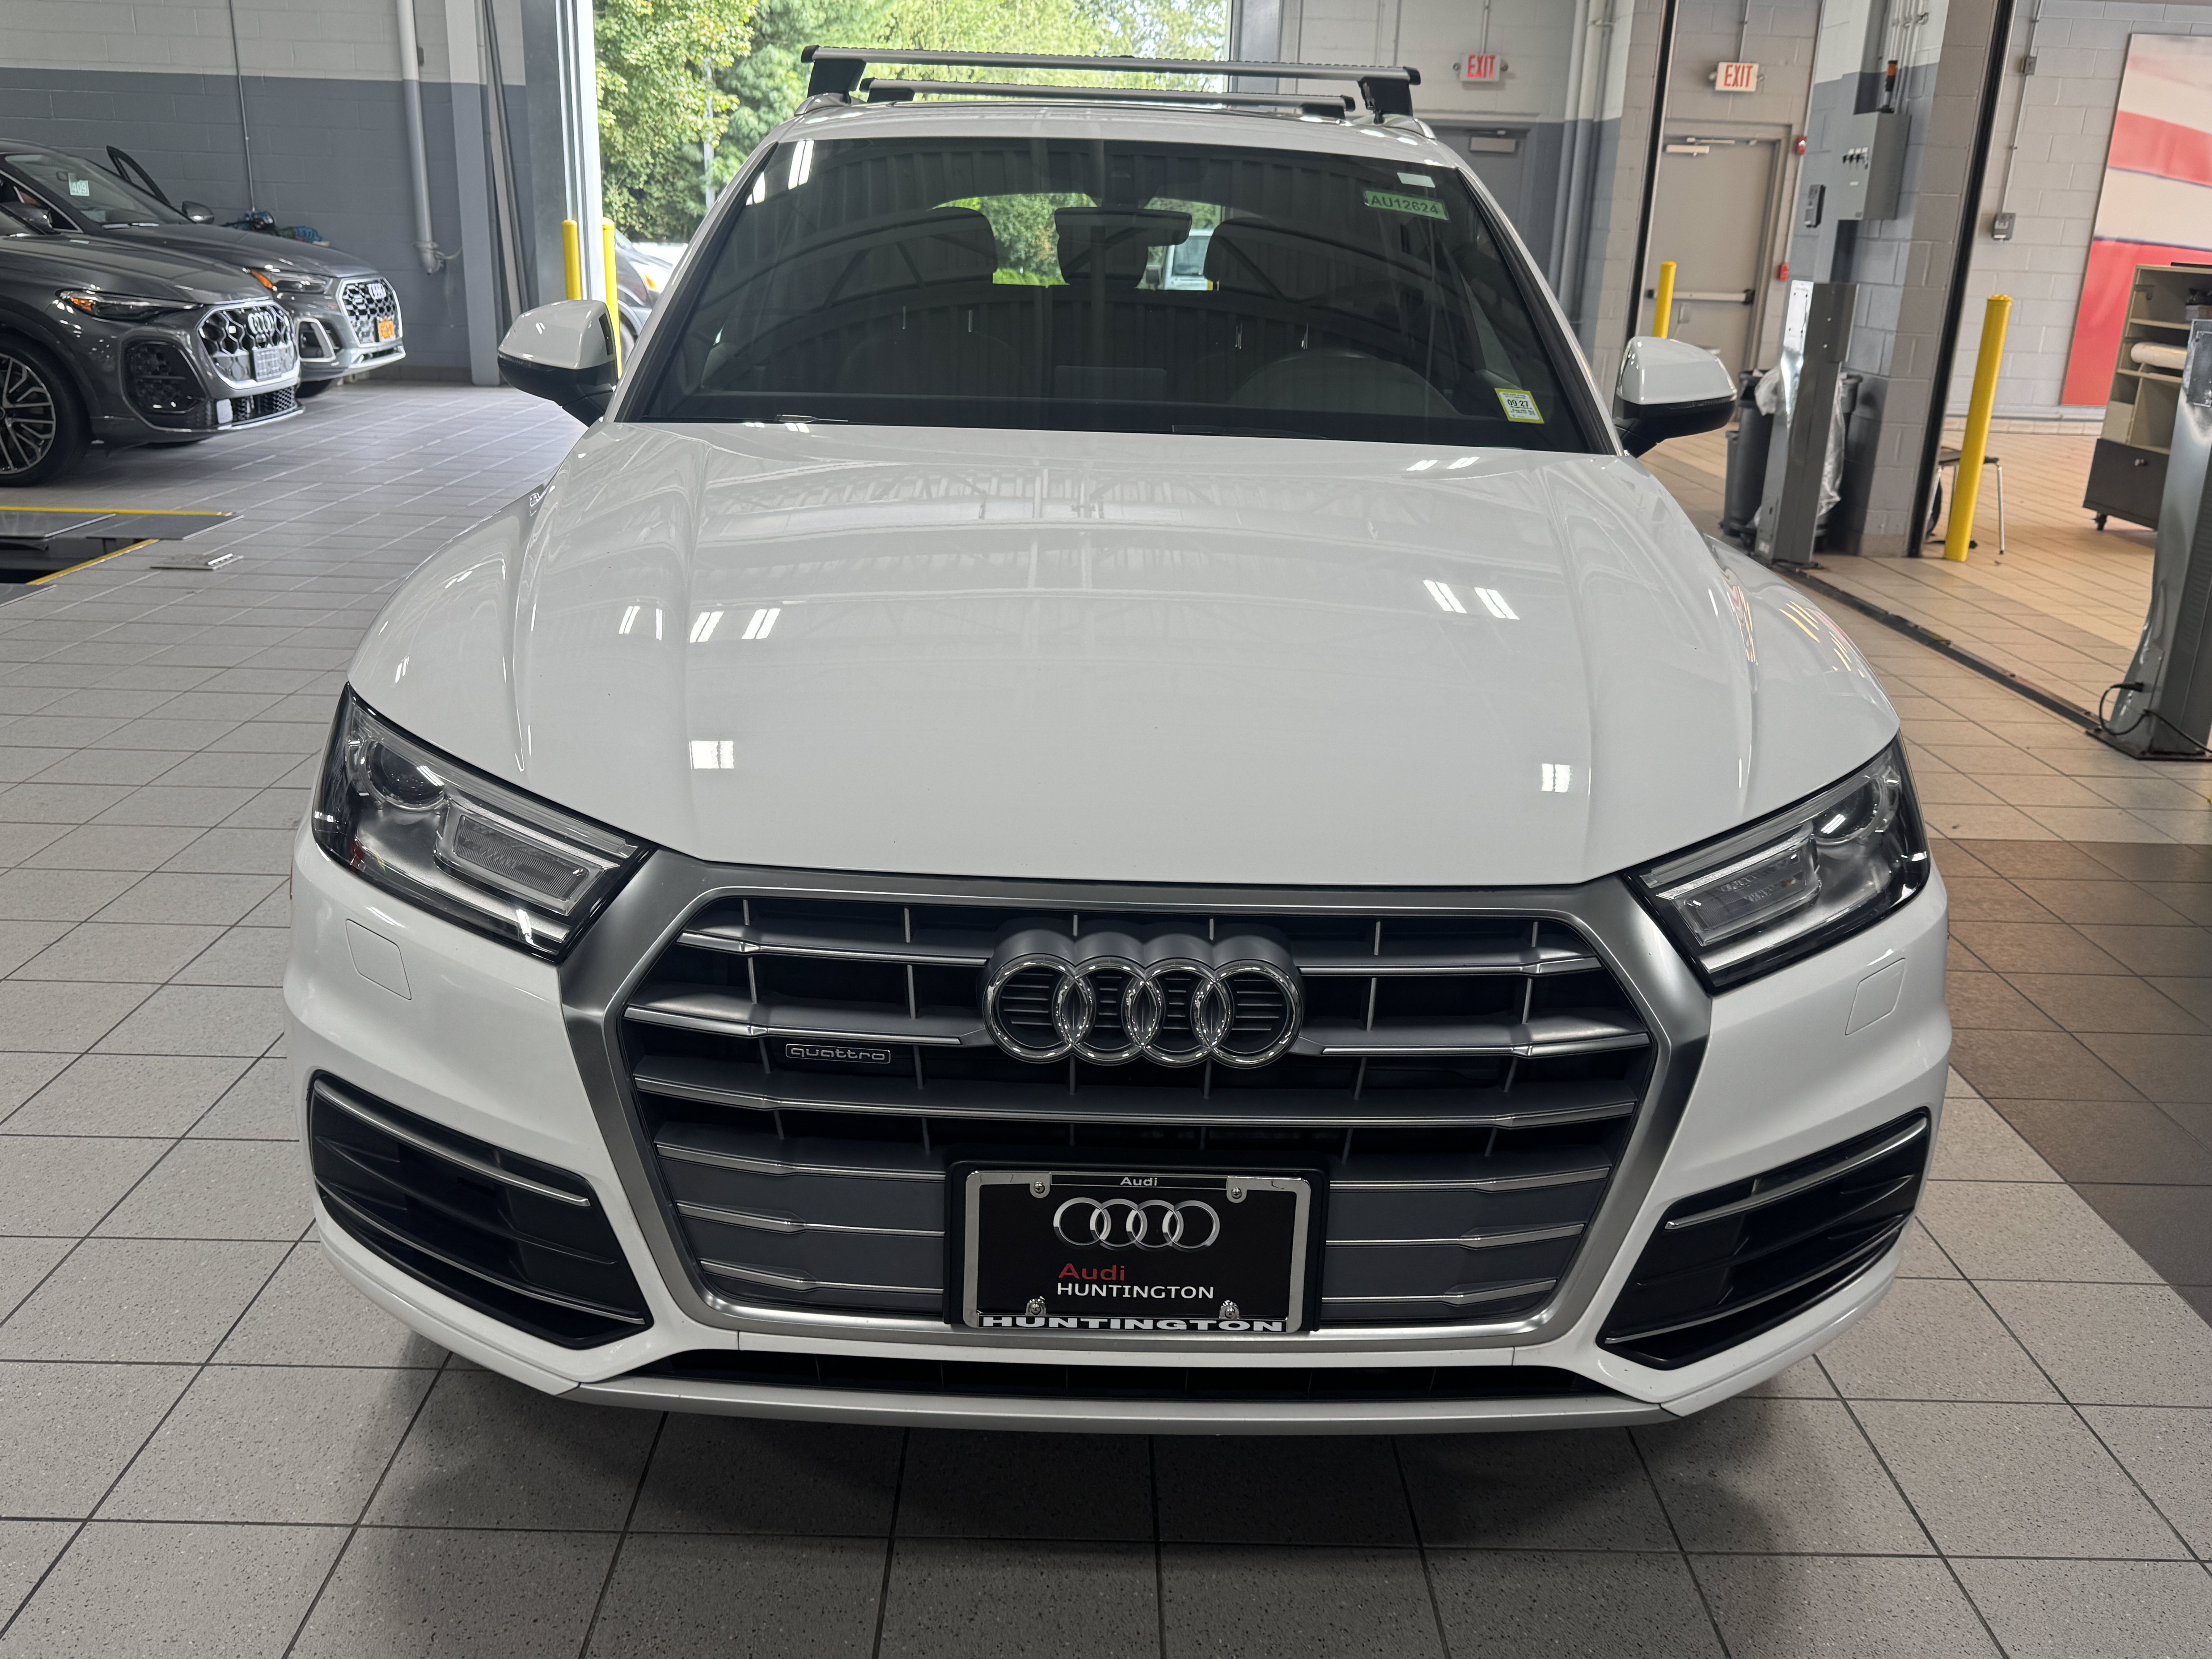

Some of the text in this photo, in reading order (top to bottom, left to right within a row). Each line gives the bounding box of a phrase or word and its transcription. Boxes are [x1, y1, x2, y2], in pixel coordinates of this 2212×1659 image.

[1467, 55, 1496, 79] EXIT
[1724, 65, 1753, 87] EXIT
[72, 181, 87, 194] 409
[1371, 195, 1438, 214] AU12624
[791, 1048, 885, 1060] quattro
[1120, 1177, 1158, 1186] Audi
[1058, 1263, 1125, 1281] Audi
[1057, 1282, 1214, 1299] HUNTINGTON
[983, 1317, 1282, 1331] HUNTINGTON
